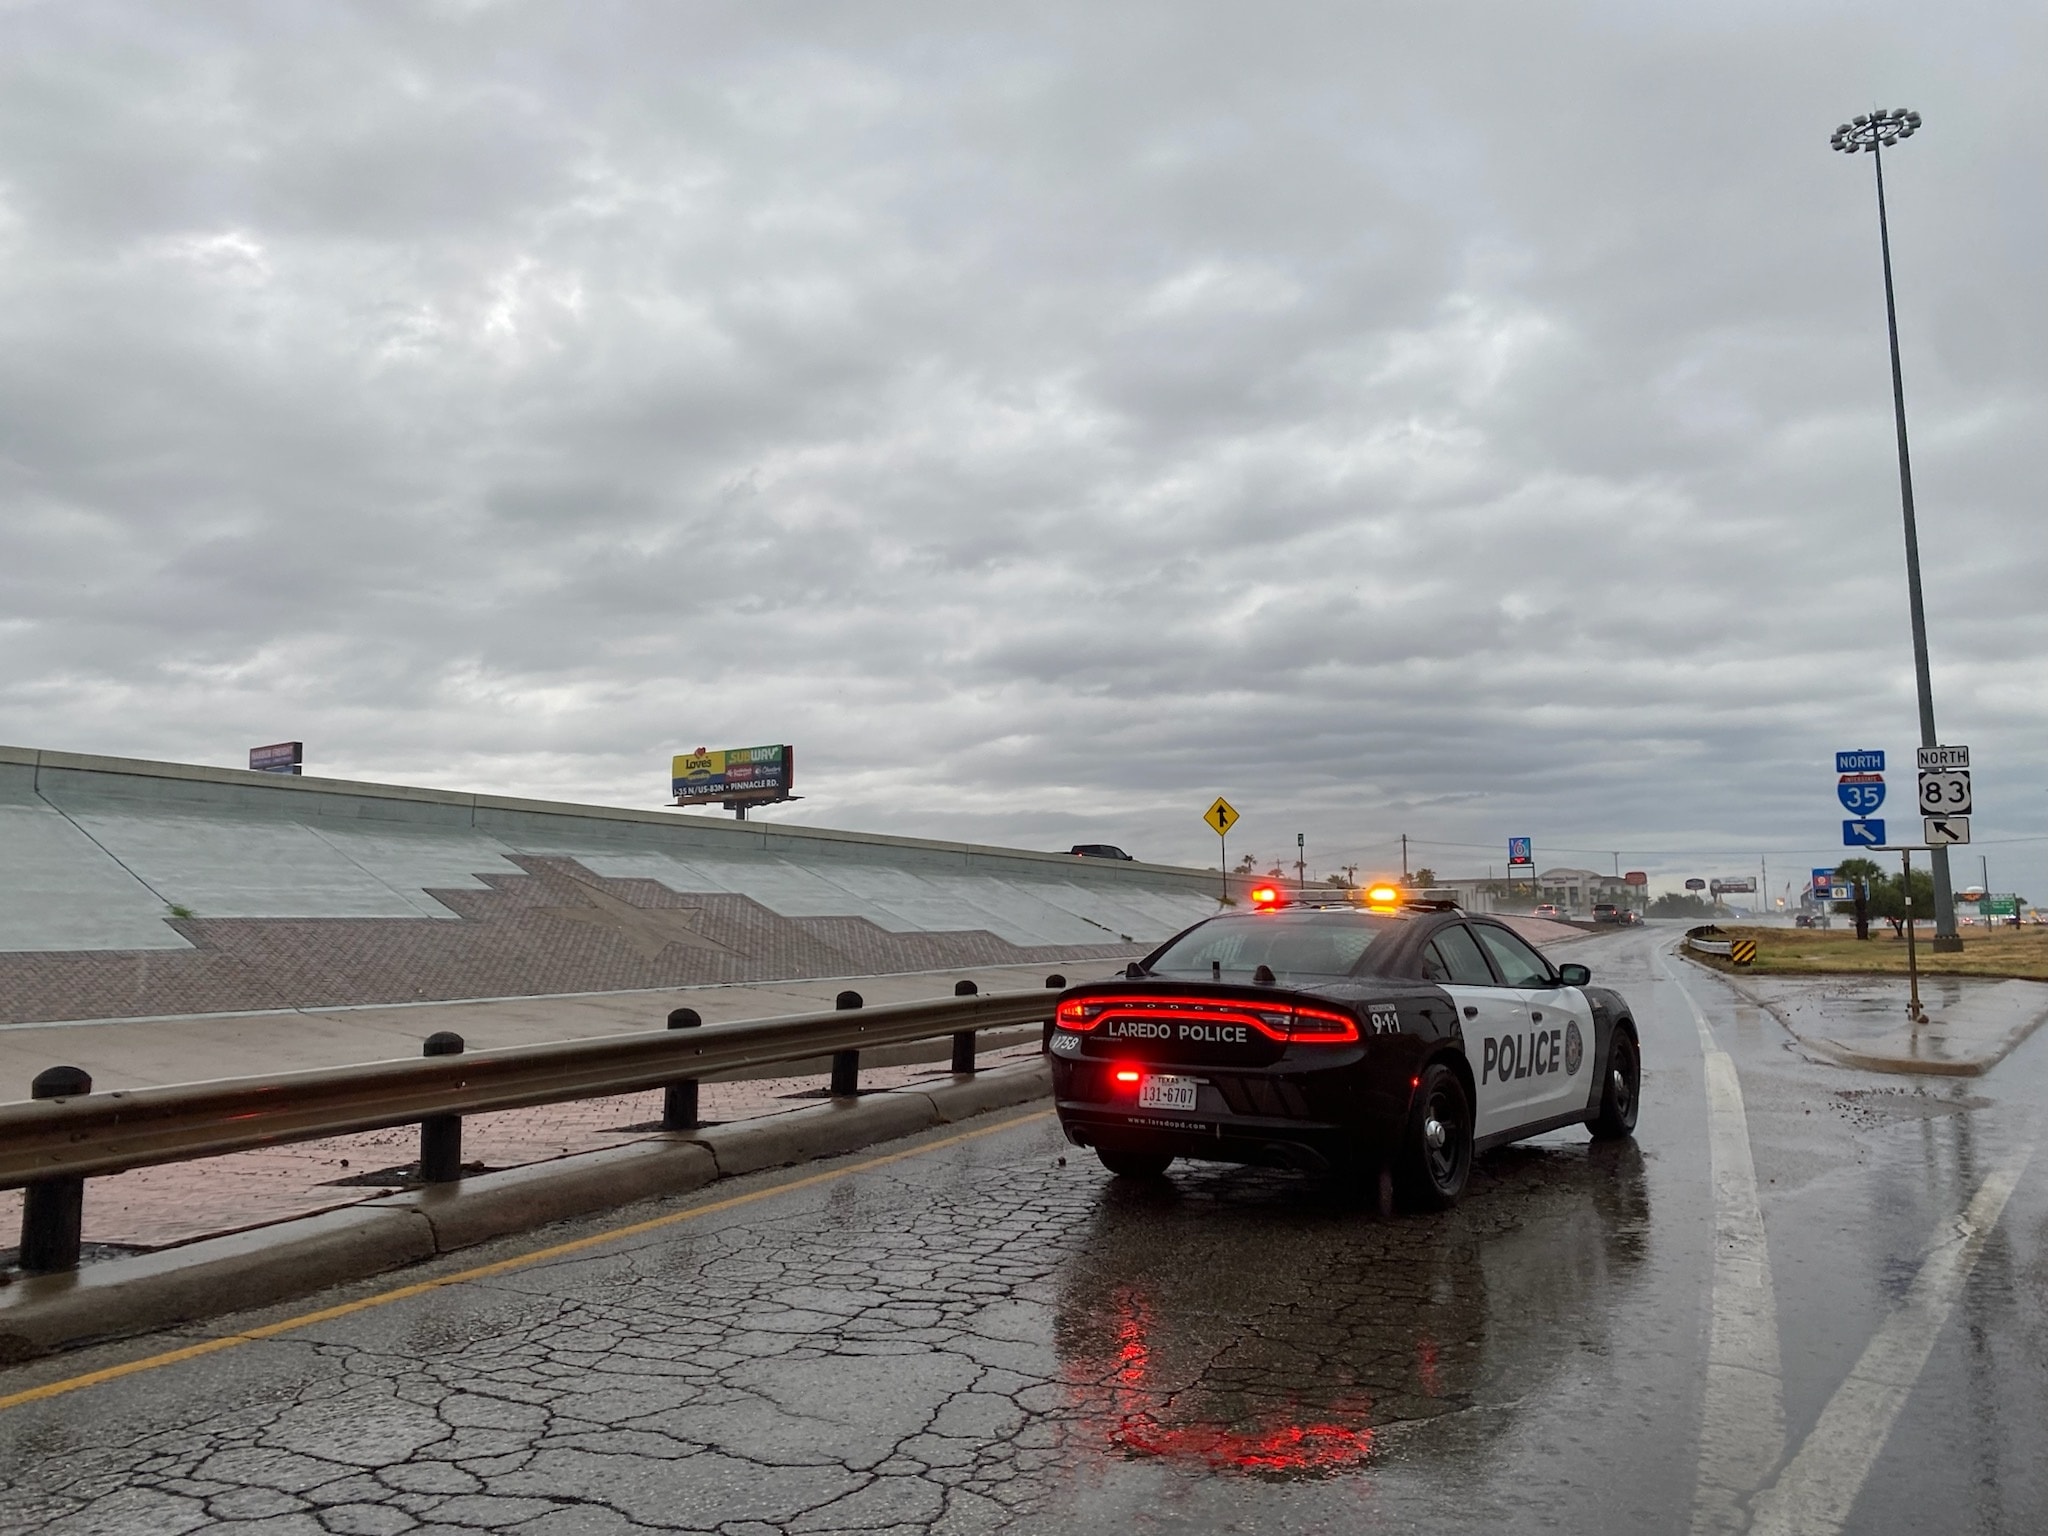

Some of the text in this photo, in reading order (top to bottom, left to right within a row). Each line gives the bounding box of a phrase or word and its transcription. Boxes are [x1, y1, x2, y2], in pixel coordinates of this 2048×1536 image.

[730, 747, 776, 764] SUBWAY
[1840, 755, 1881, 768] NORTH
[1920, 751, 1966, 764] NORTH
[731, 780, 766, 791] PINNACLE
[766, 778, 779, 788] RD.
[1925, 780, 1965, 804] 83
[1847, 787, 1879, 807] 35
[1513, 839, 1526, 856] 6
[1125, 1003, 1229, 1012] DODGE
[1108, 1021, 1247, 1043] LAREDO POLICE
[1053, 1035, 1079, 1050] 1758
[1482, 1029, 1561, 1085] POLICE
[1158, 1076, 1180, 1084] TEXAS
